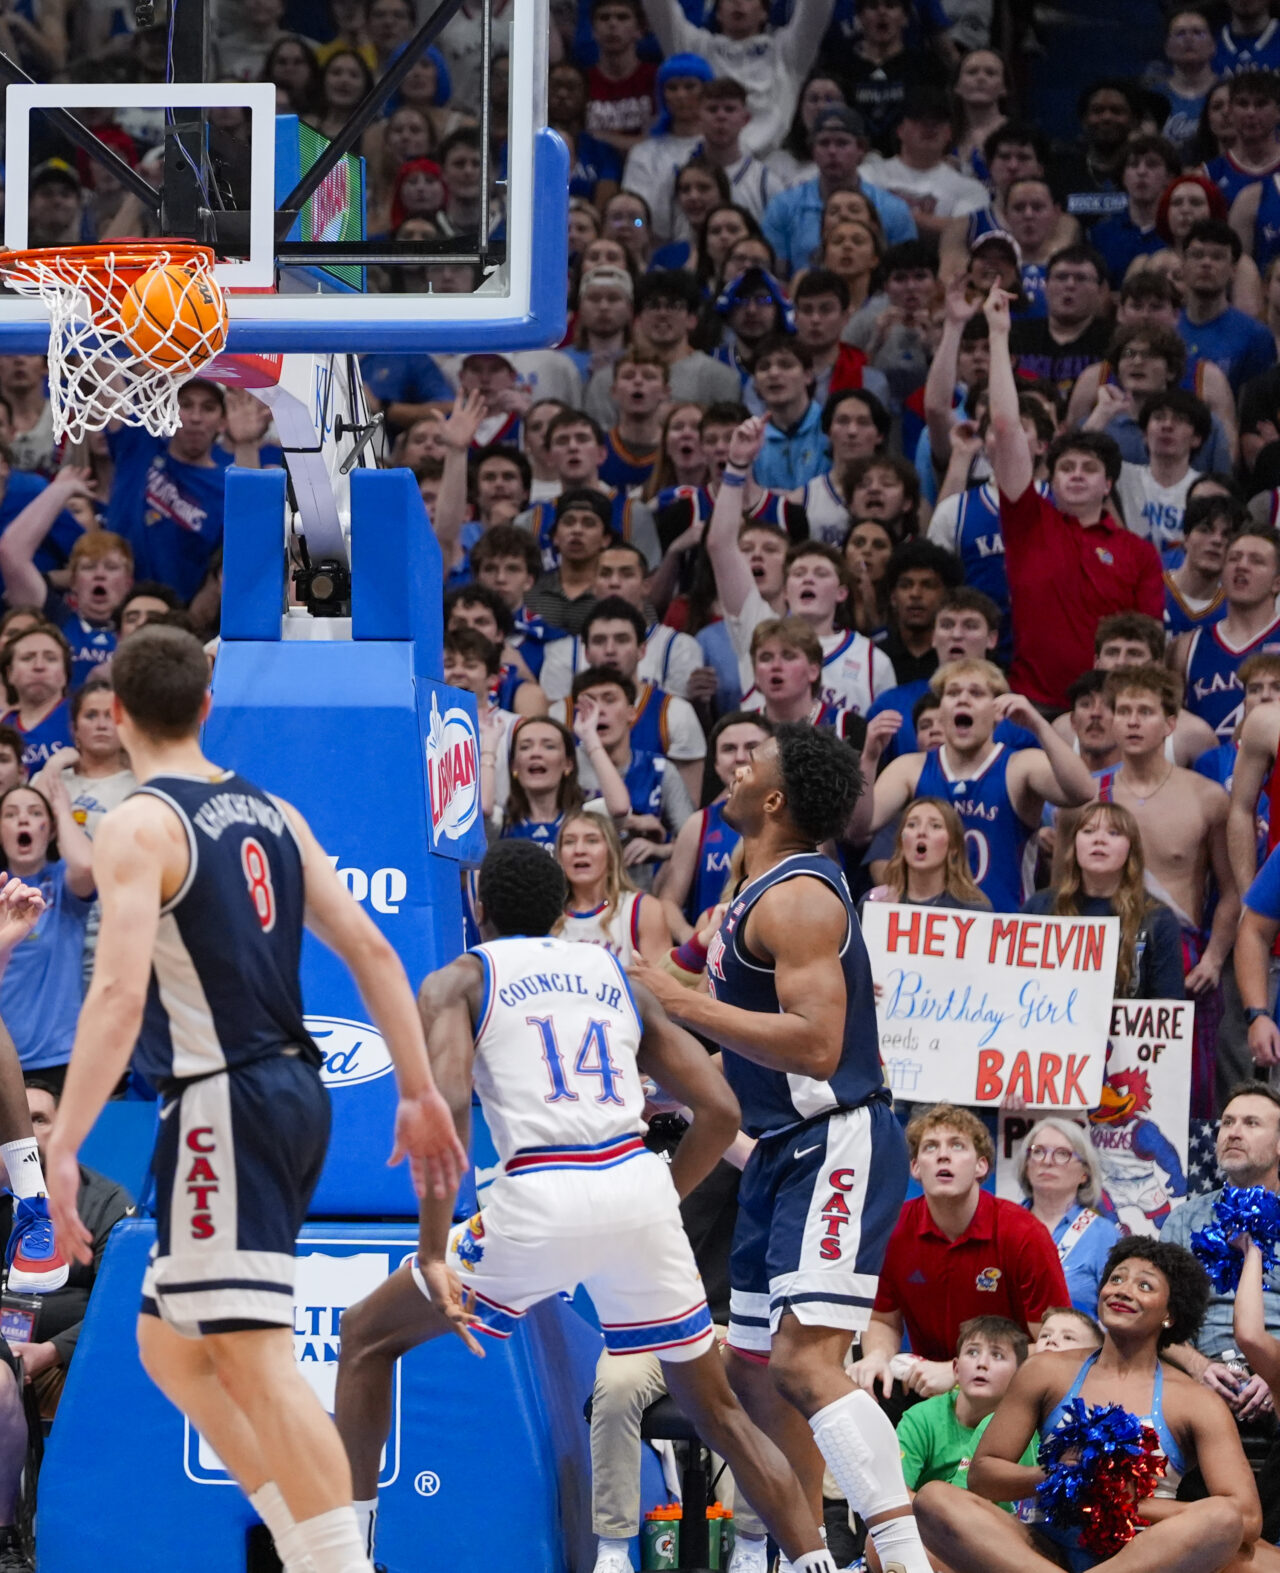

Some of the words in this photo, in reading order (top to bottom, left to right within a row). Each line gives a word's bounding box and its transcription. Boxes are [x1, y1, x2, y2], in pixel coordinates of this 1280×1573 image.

[241, 837, 278, 934] 8
[886, 911, 977, 960] HEY
[988, 919, 1107, 972] MELVIN
[499, 972, 589, 1008] COUNCIL
[595, 982, 624, 1014] JR.
[885, 967, 1015, 1048] Birthday
[1018, 978, 1080, 1029] Girl
[881, 1027, 920, 1051] eeds
[928, 1036, 941, 1050] a
[1110, 1006, 1185, 1042] EWARE
[1138, 1043, 1166, 1064] OF
[525, 1015, 625, 1108] 14
[976, 1048, 1091, 1107] BARK
[185, 1126, 218, 1241] CATS
[819, 1167, 855, 1262] CATS
